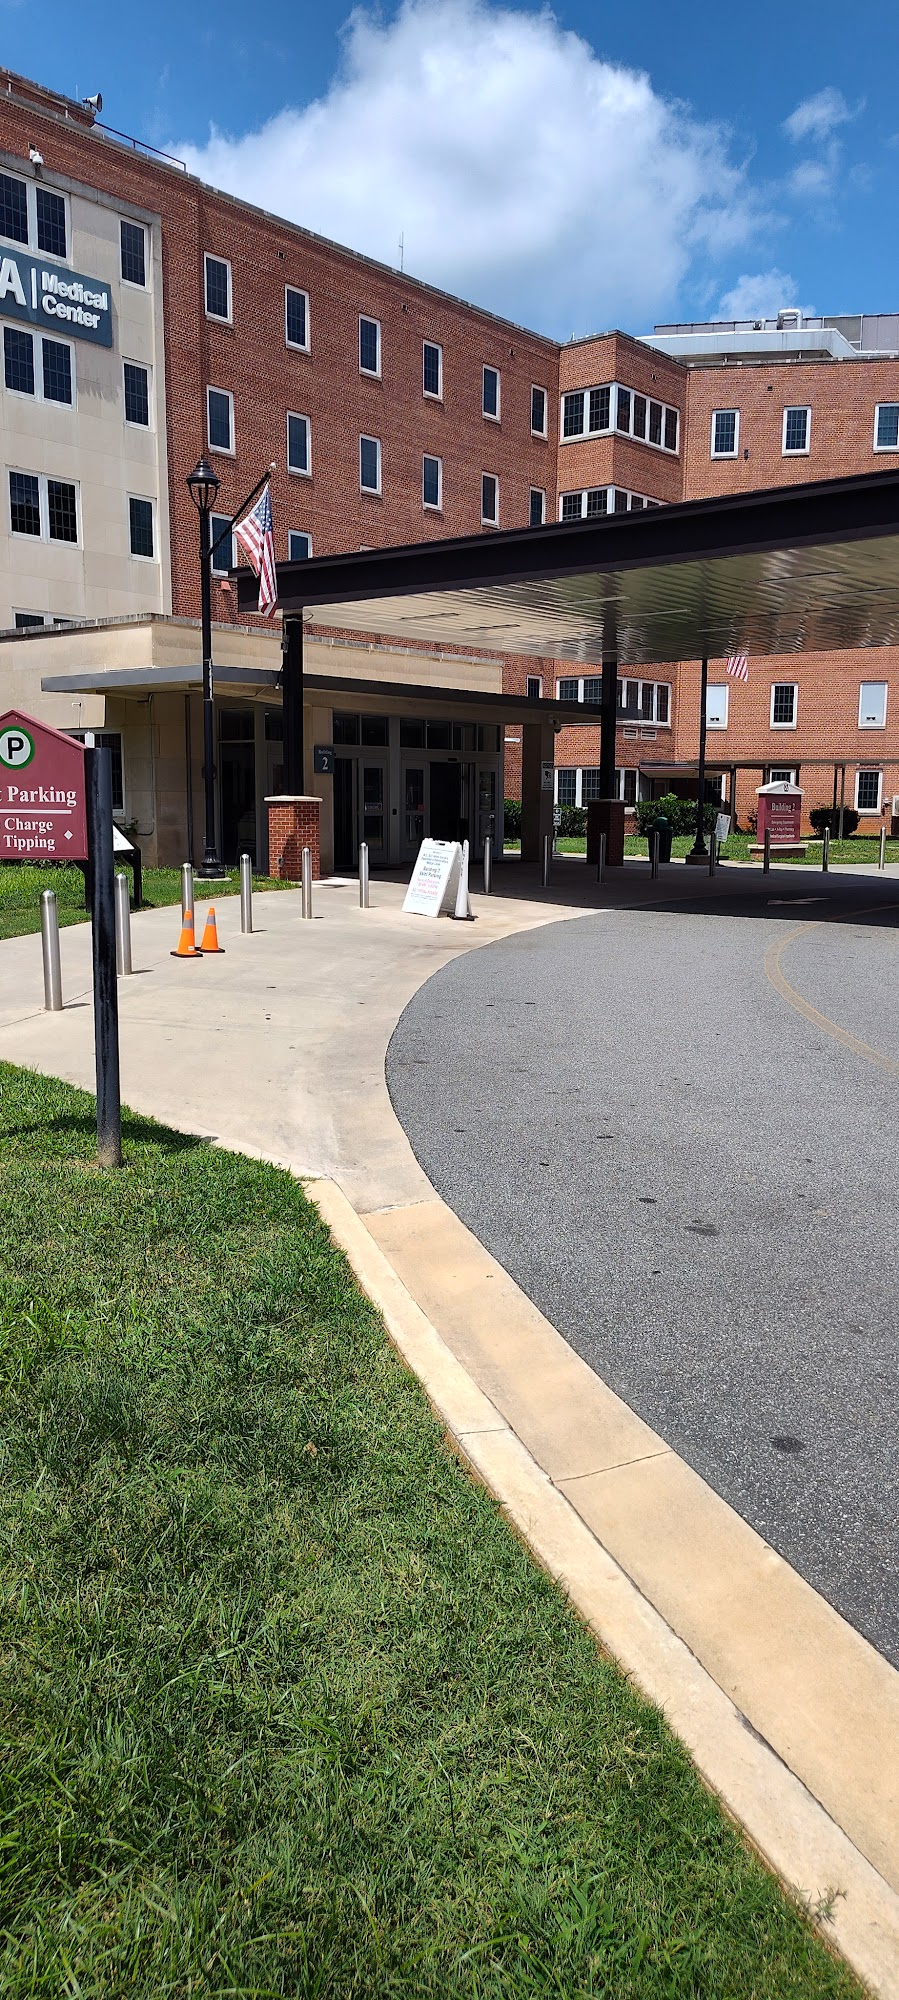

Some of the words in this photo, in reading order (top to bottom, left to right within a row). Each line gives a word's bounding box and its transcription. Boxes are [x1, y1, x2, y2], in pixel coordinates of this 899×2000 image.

[0, 255, 27, 306] A
[41, 271, 108, 311] Medical
[42, 294, 101, 329] Center
[7, 737, 24, 760] P
[322, 757, 328, 770] 2
[7, 786, 77, 807] Parking
[771, 802, 792, 813] Building
[4, 817, 54, 834] Charge
[3, 835, 56, 852] Tipping
